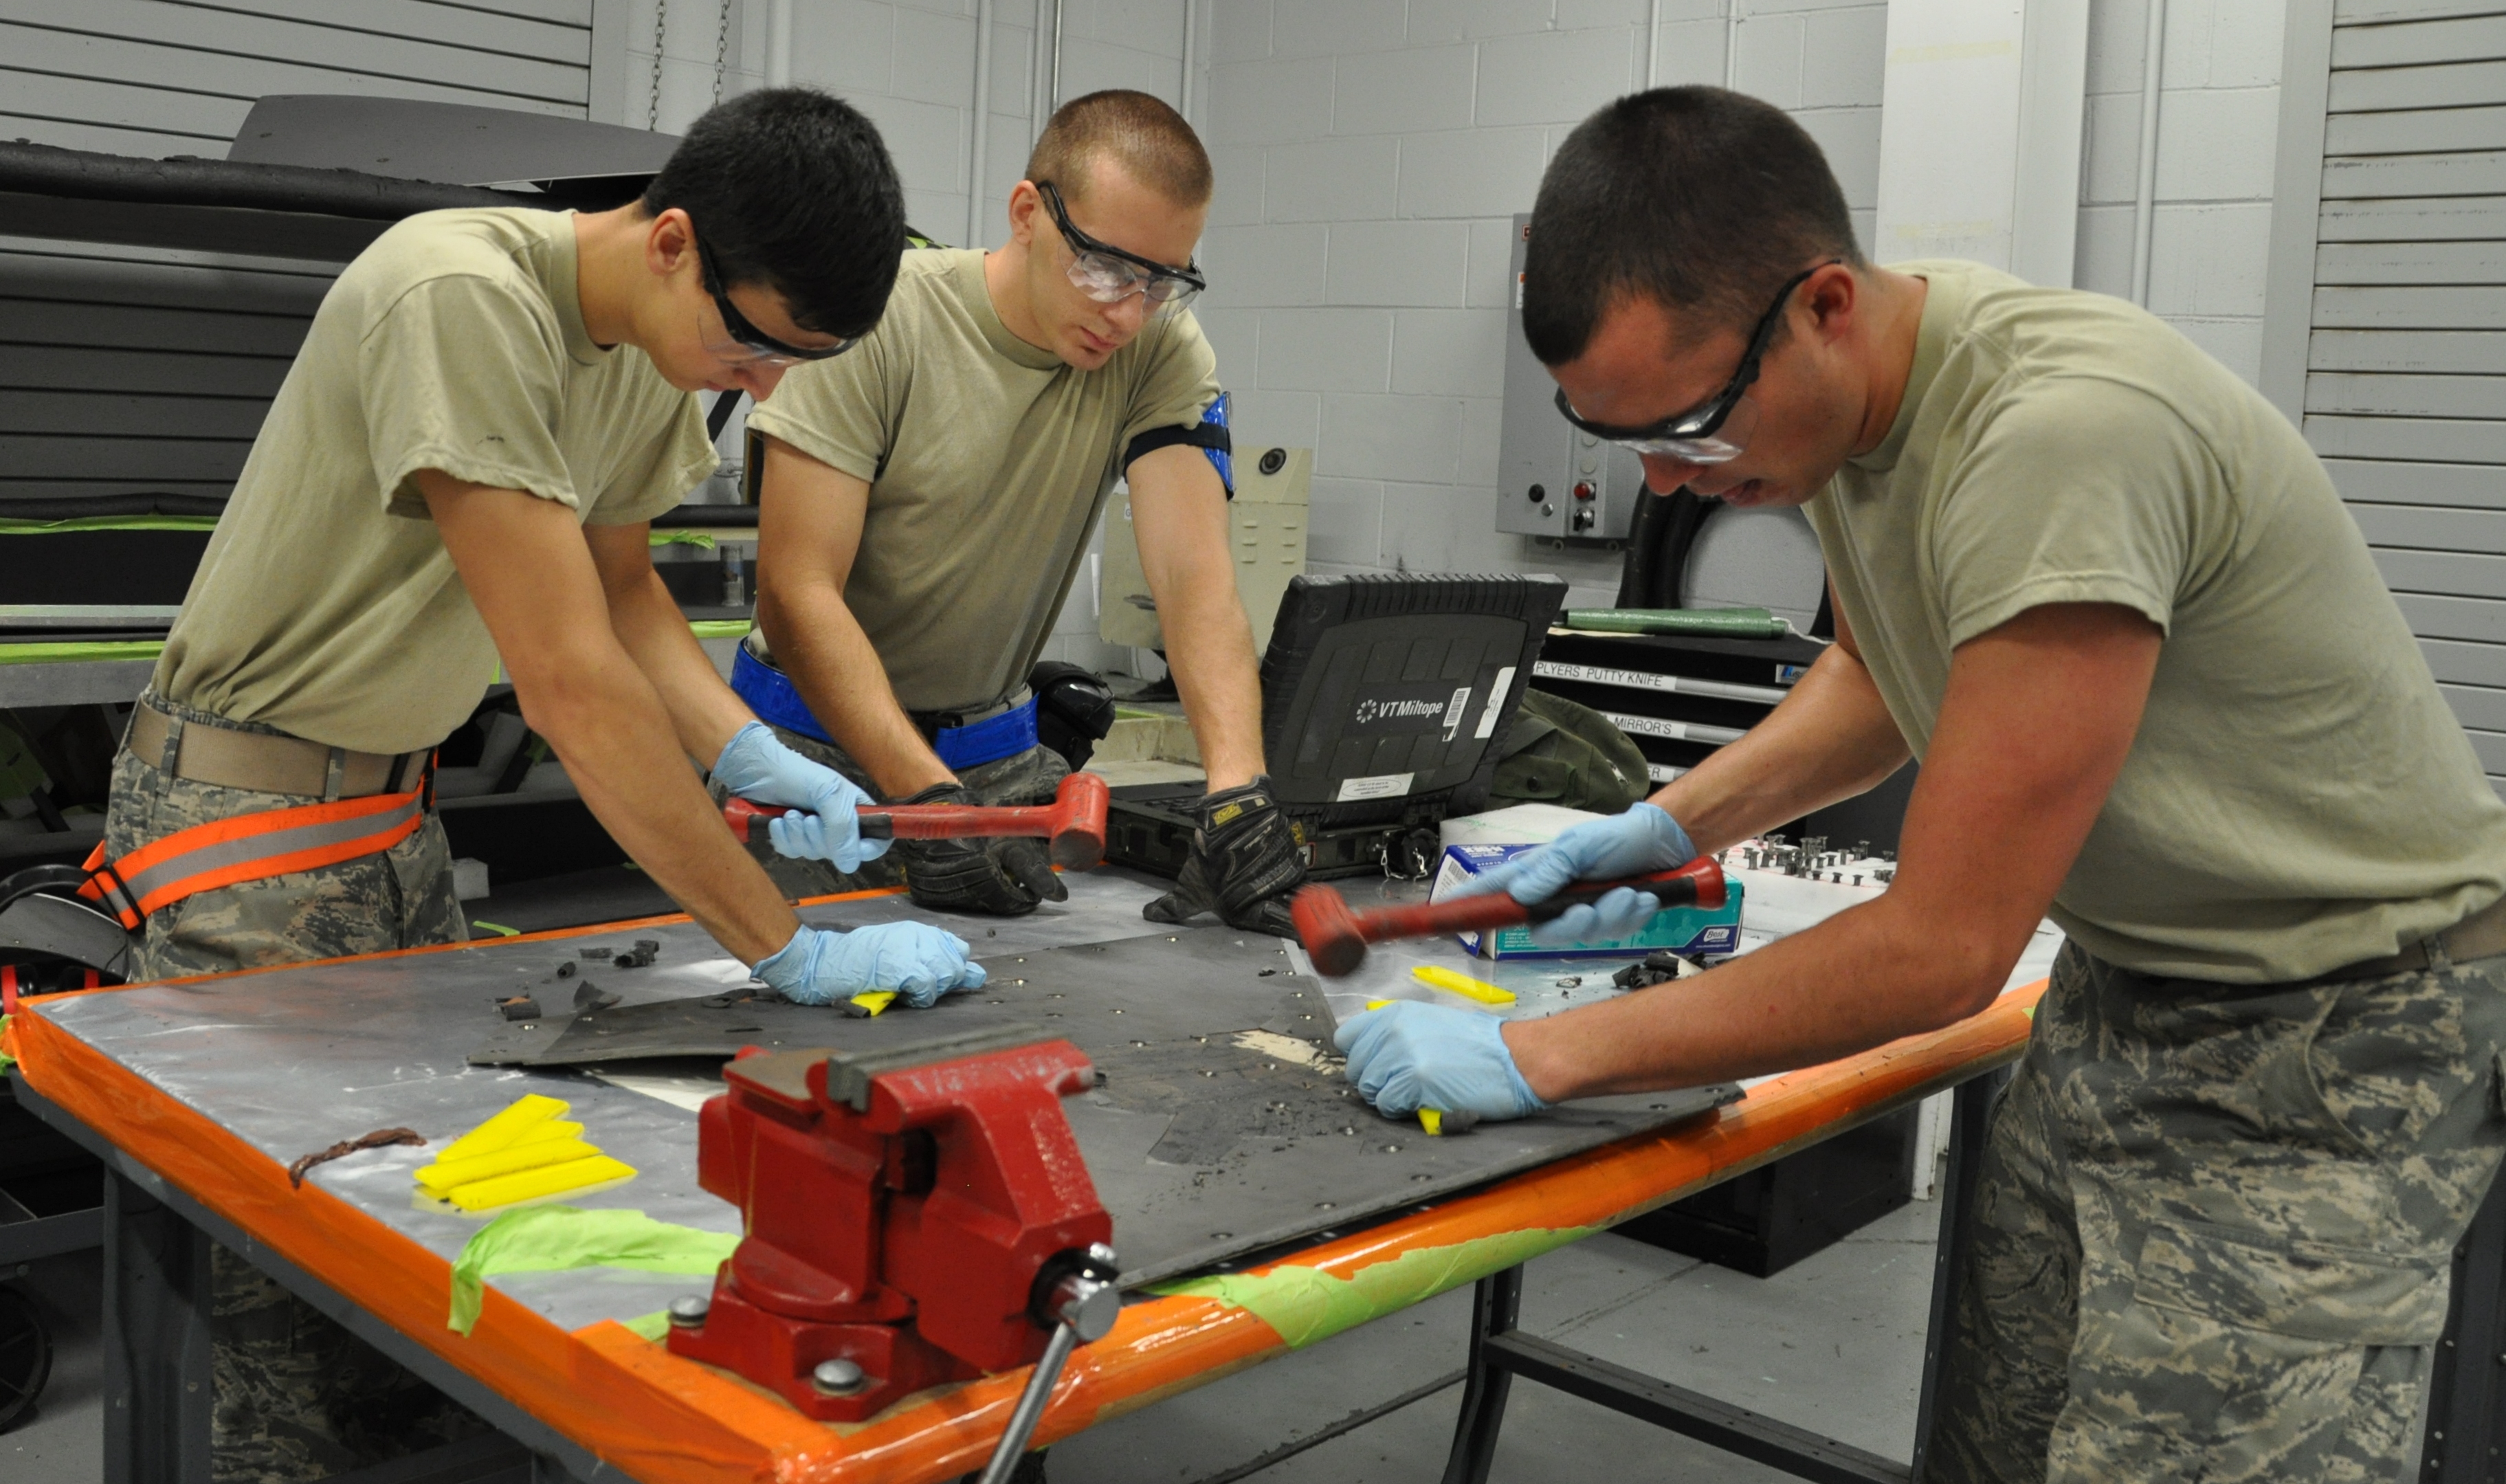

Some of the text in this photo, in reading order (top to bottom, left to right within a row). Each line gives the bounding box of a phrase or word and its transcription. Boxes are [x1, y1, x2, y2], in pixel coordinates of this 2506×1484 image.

[1535, 662, 1663, 687] PLYERS PUTTY KNIFE
[1615, 716, 1672, 735] MIRROR'S
[1706, 931, 1724, 939] Best
